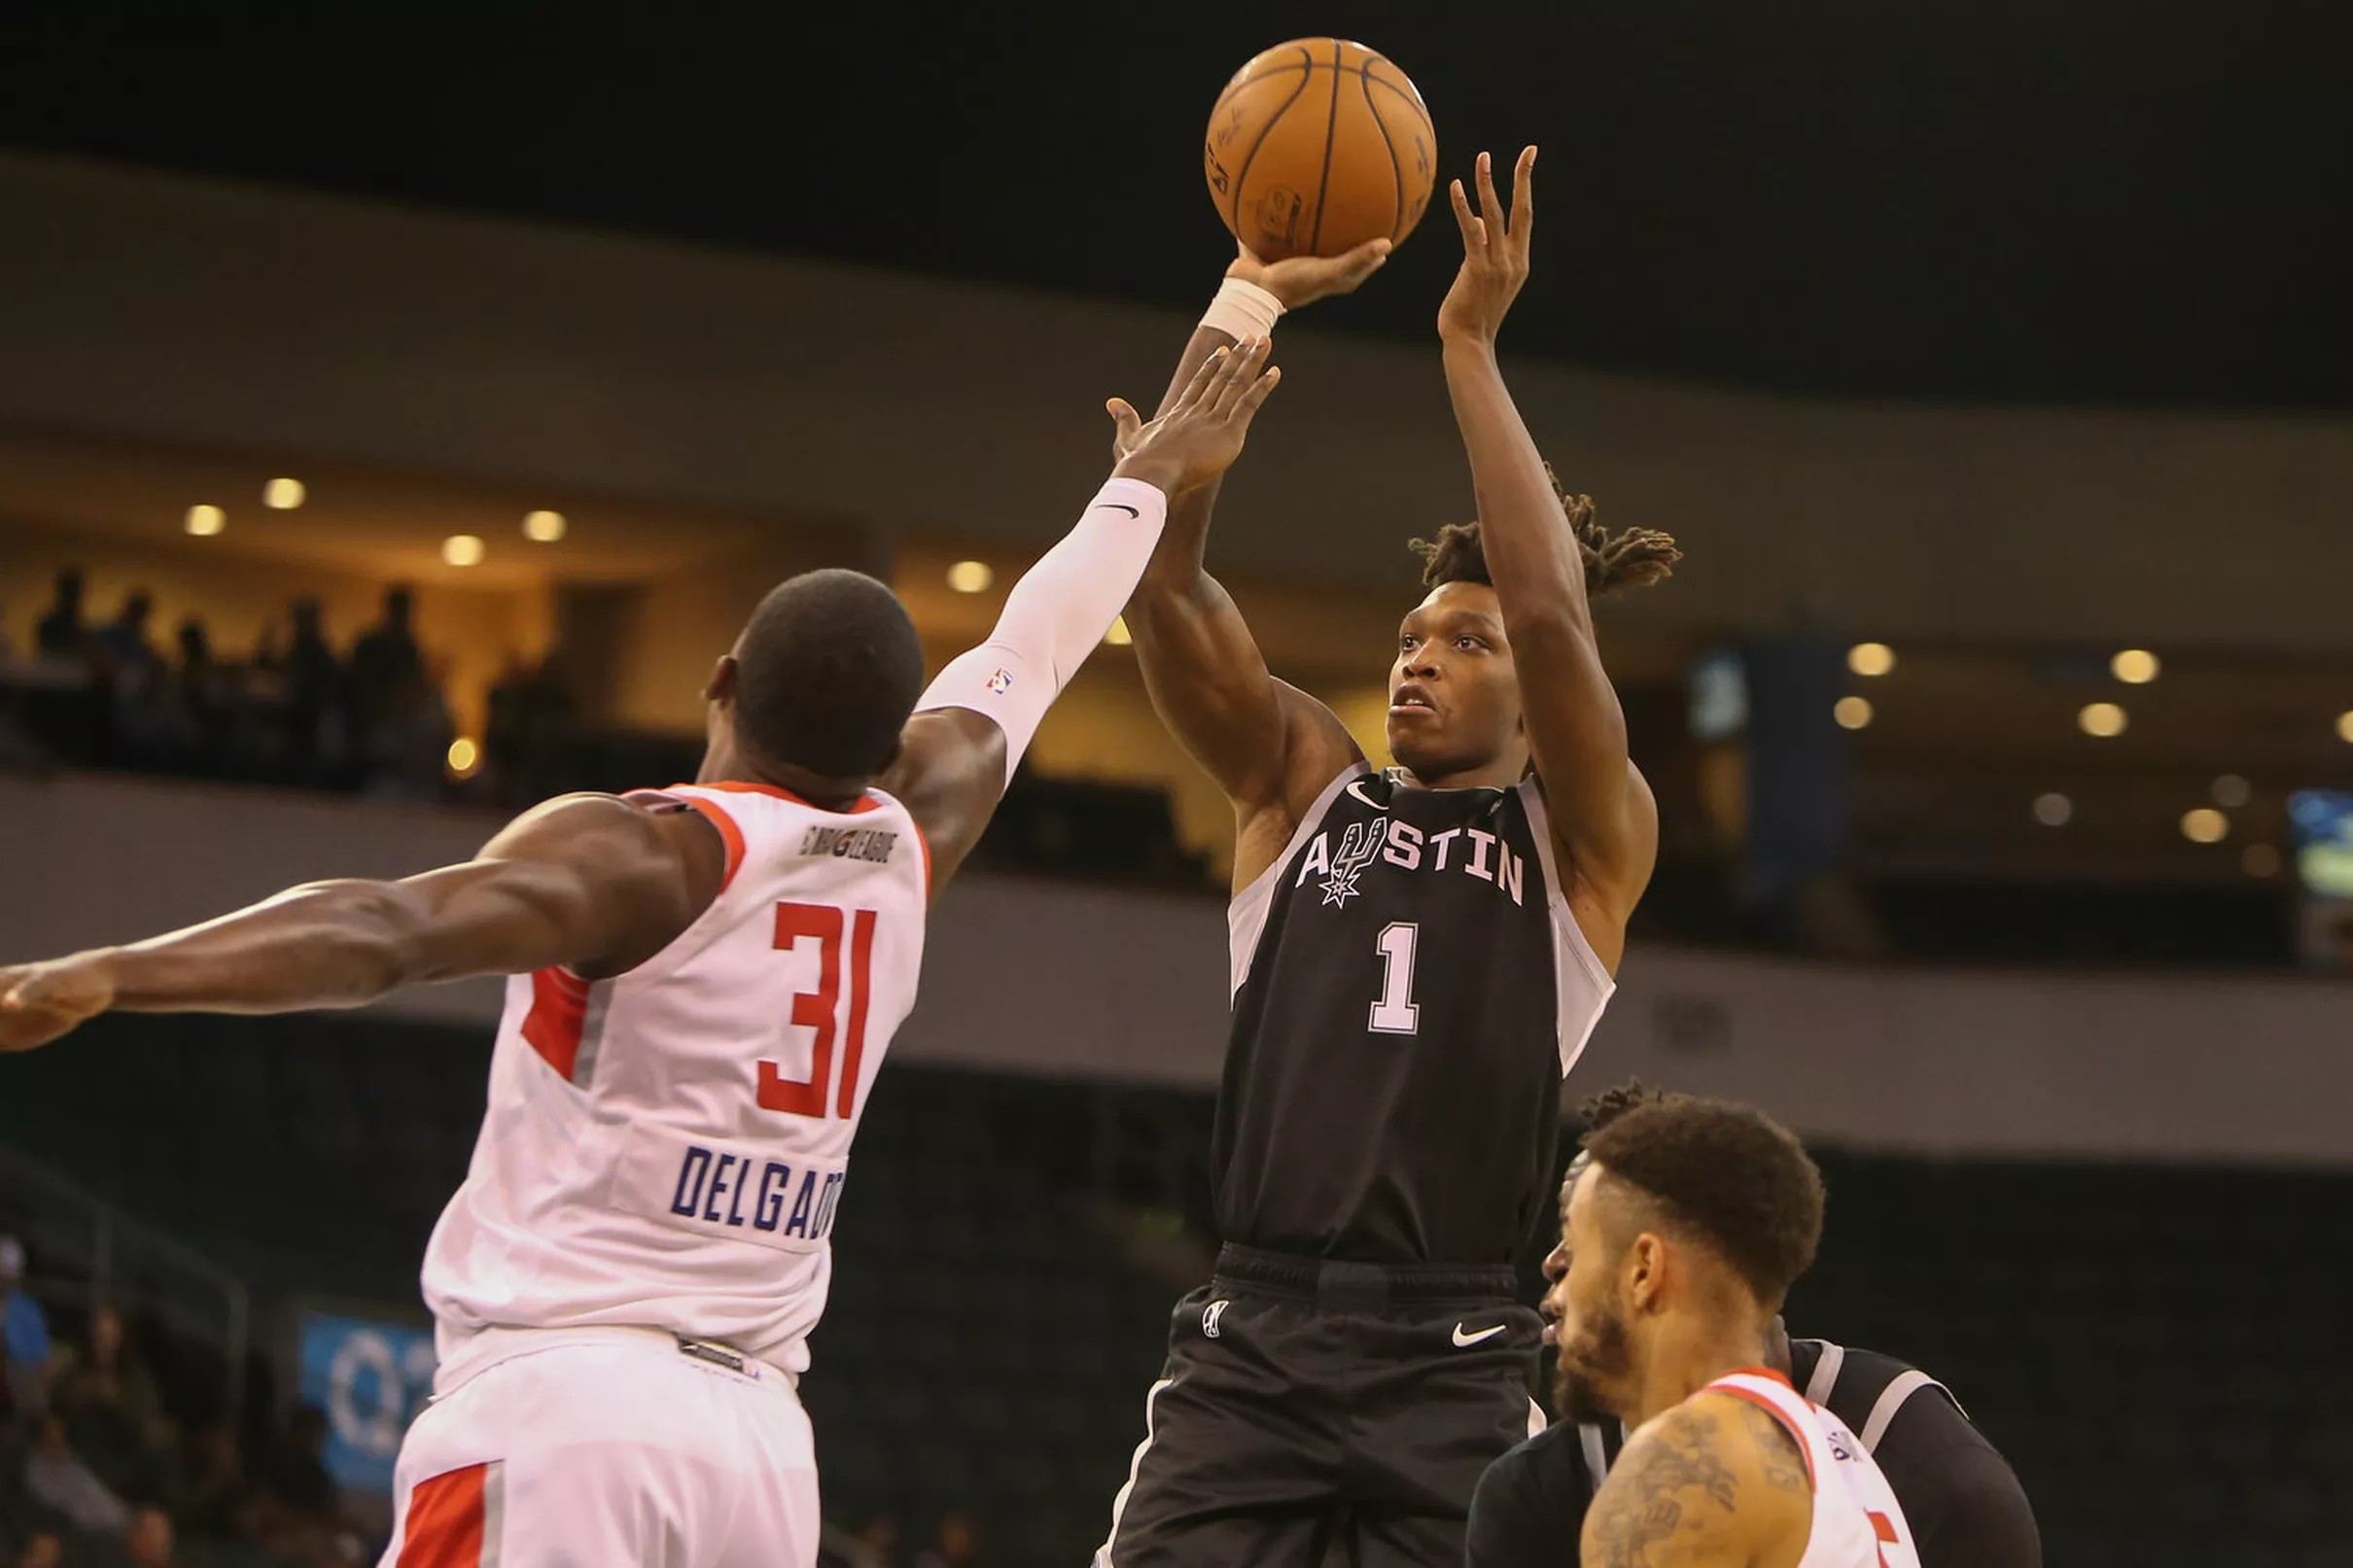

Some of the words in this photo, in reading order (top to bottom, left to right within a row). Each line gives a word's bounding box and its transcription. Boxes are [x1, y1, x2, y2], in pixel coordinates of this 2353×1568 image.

[1295, 816, 1524, 909] AUSTIN
[756, 900, 877, 1120] 31
[1368, 921, 1420, 1035] 1
